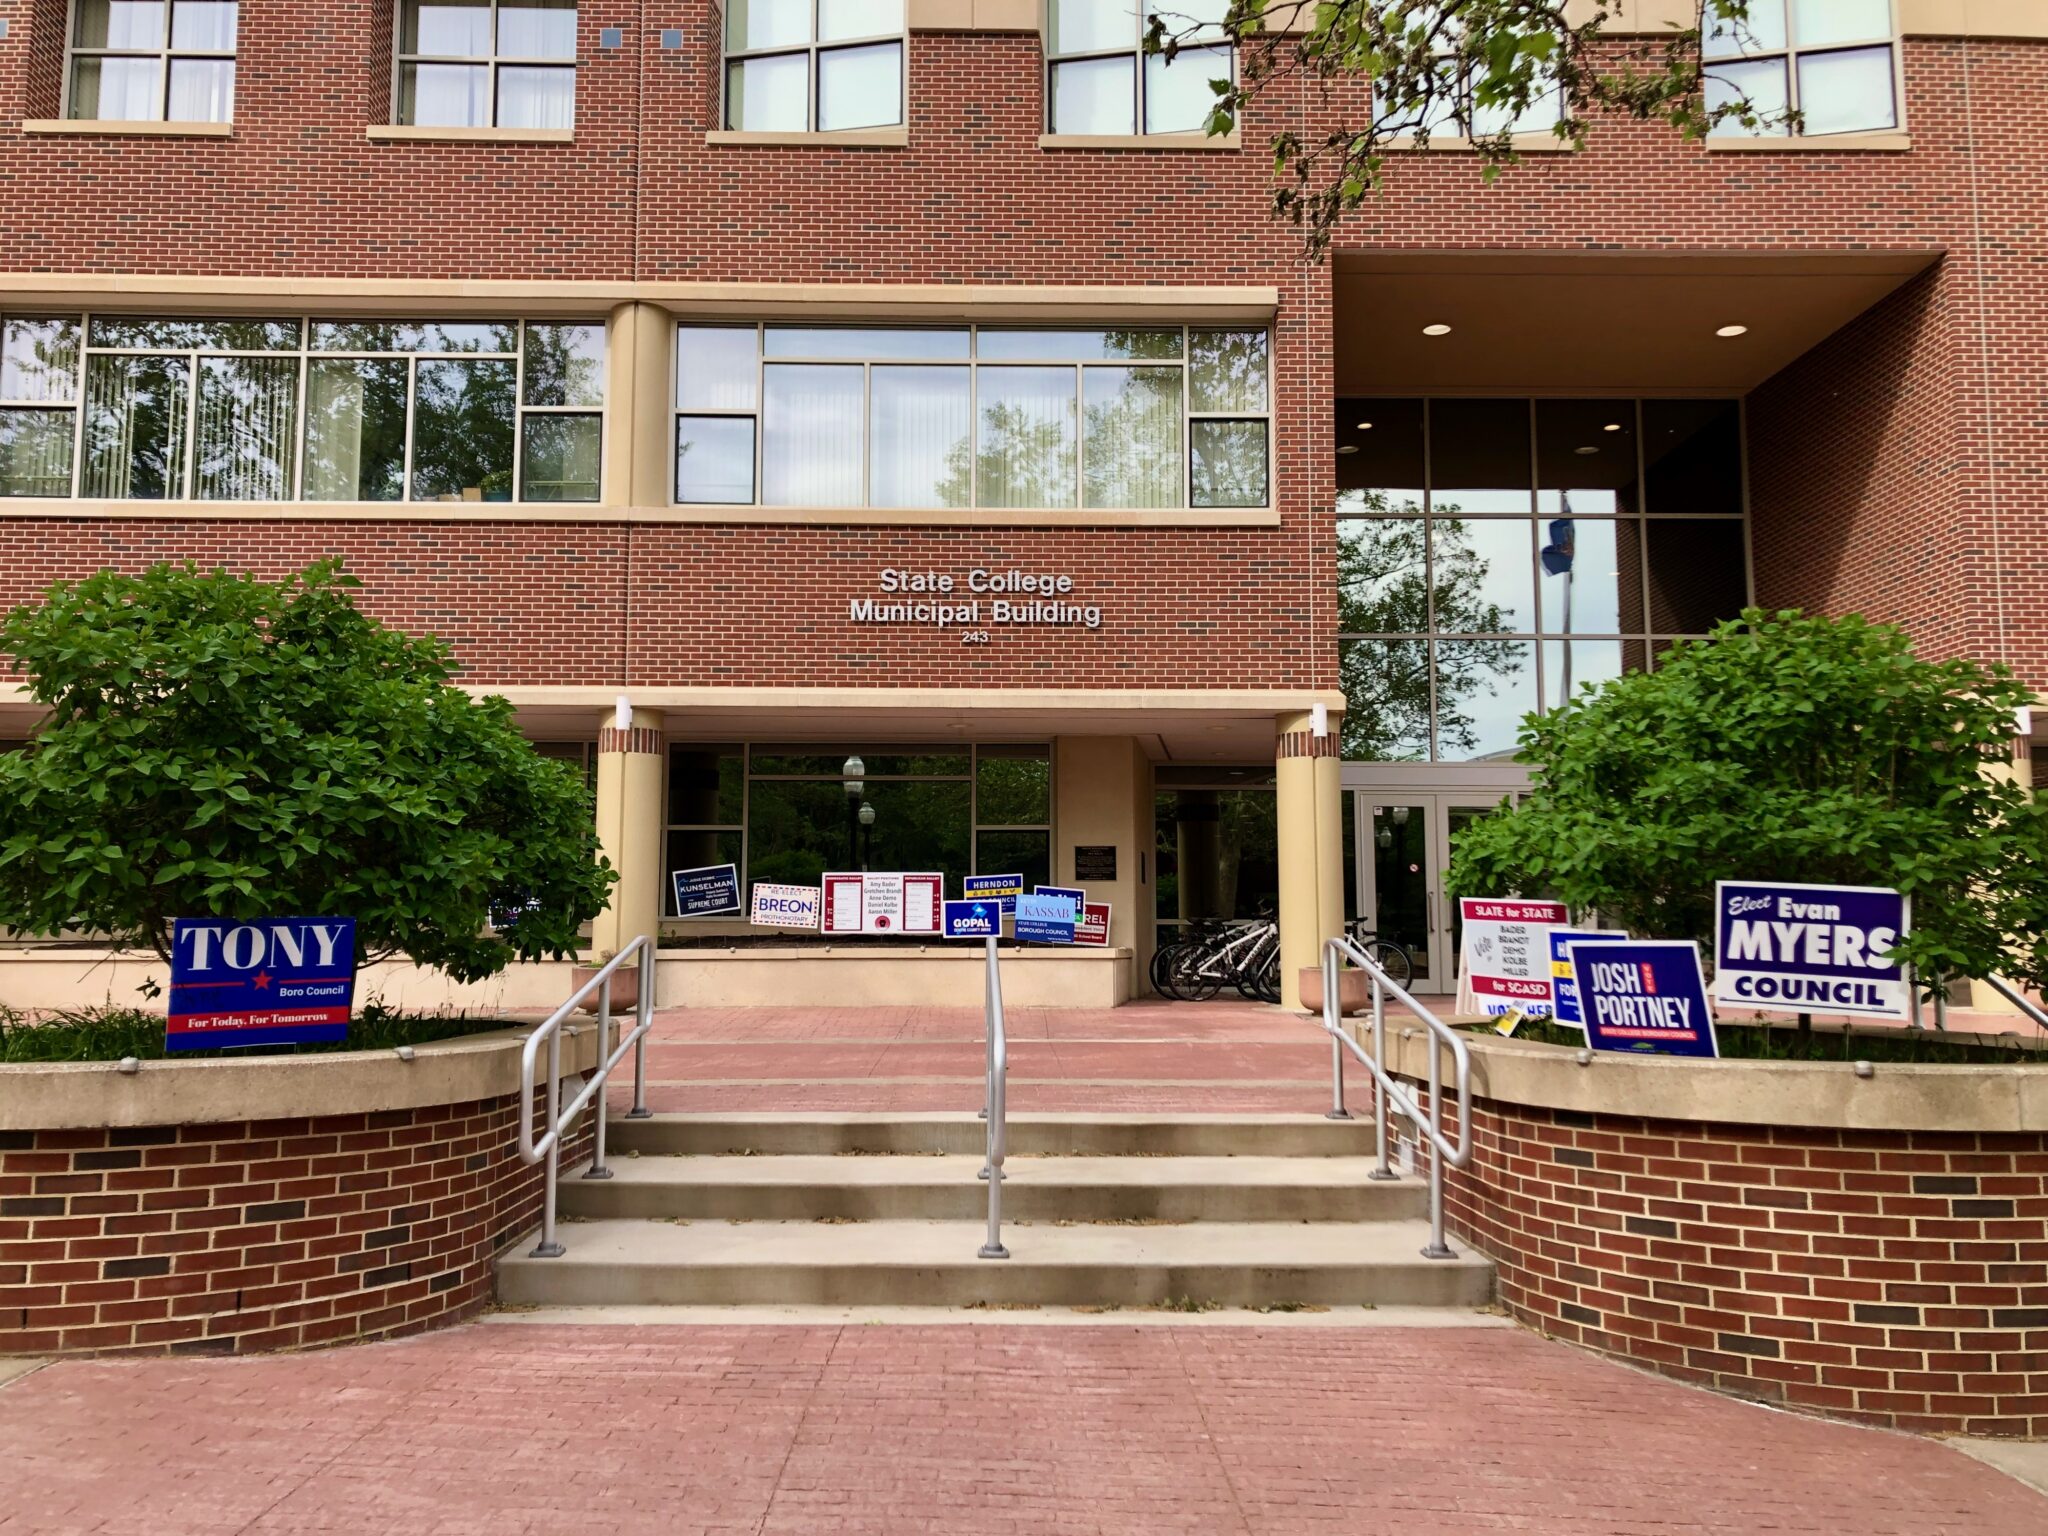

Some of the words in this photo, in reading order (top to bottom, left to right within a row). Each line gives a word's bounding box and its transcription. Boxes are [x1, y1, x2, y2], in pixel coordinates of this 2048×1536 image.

[880, 568, 954, 592] State
[968, 569, 1073, 597] College
[850, 600, 979, 627] Municipal
[993, 600, 1100, 628] Building
[962, 631, 989, 643] 243
[680, 880, 733, 893] KUNSELMAN
[973, 880, 1015, 889] HERNDON
[688, 900, 710, 910] SUPREME
[711, 897, 728, 906] COURT
[759, 898, 812, 913] BREON
[1728, 895, 1772, 915] Elect
[1777, 896, 1840, 920] Evan
[761, 914, 808, 922] PROTHONOTARY
[1025, 906, 1069, 918] KASSAB
[1475, 905, 1504, 917] SLATE
[1506, 908, 1520, 918] for
[1522, 907, 1556, 919] STATE
[954, 918, 991, 927] GOPAL
[1500, 925, 1527, 934] BADER
[1498, 935, 1530, 944] BRANDT
[1727, 919, 1896, 970] MYERS
[181, 925, 347, 971] TONY
[1503, 946, 1526, 955] DEMO
[1503, 957, 1528, 966] KOLBE
[1503, 967, 1529, 976] MILLER
[1590, 962, 1642, 994] JOSH
[280, 987, 304, 997] Boro
[306, 984, 344, 996] Council
[1492, 980, 1505, 992] for
[1735, 976, 1884, 1006] COUNCIL
[1594, 995, 1690, 1028] PORTNEY
[188, 1018, 208, 1028] For
[249, 1015, 269, 1025] For
[271, 1013, 328, 1024] Tomorrow
